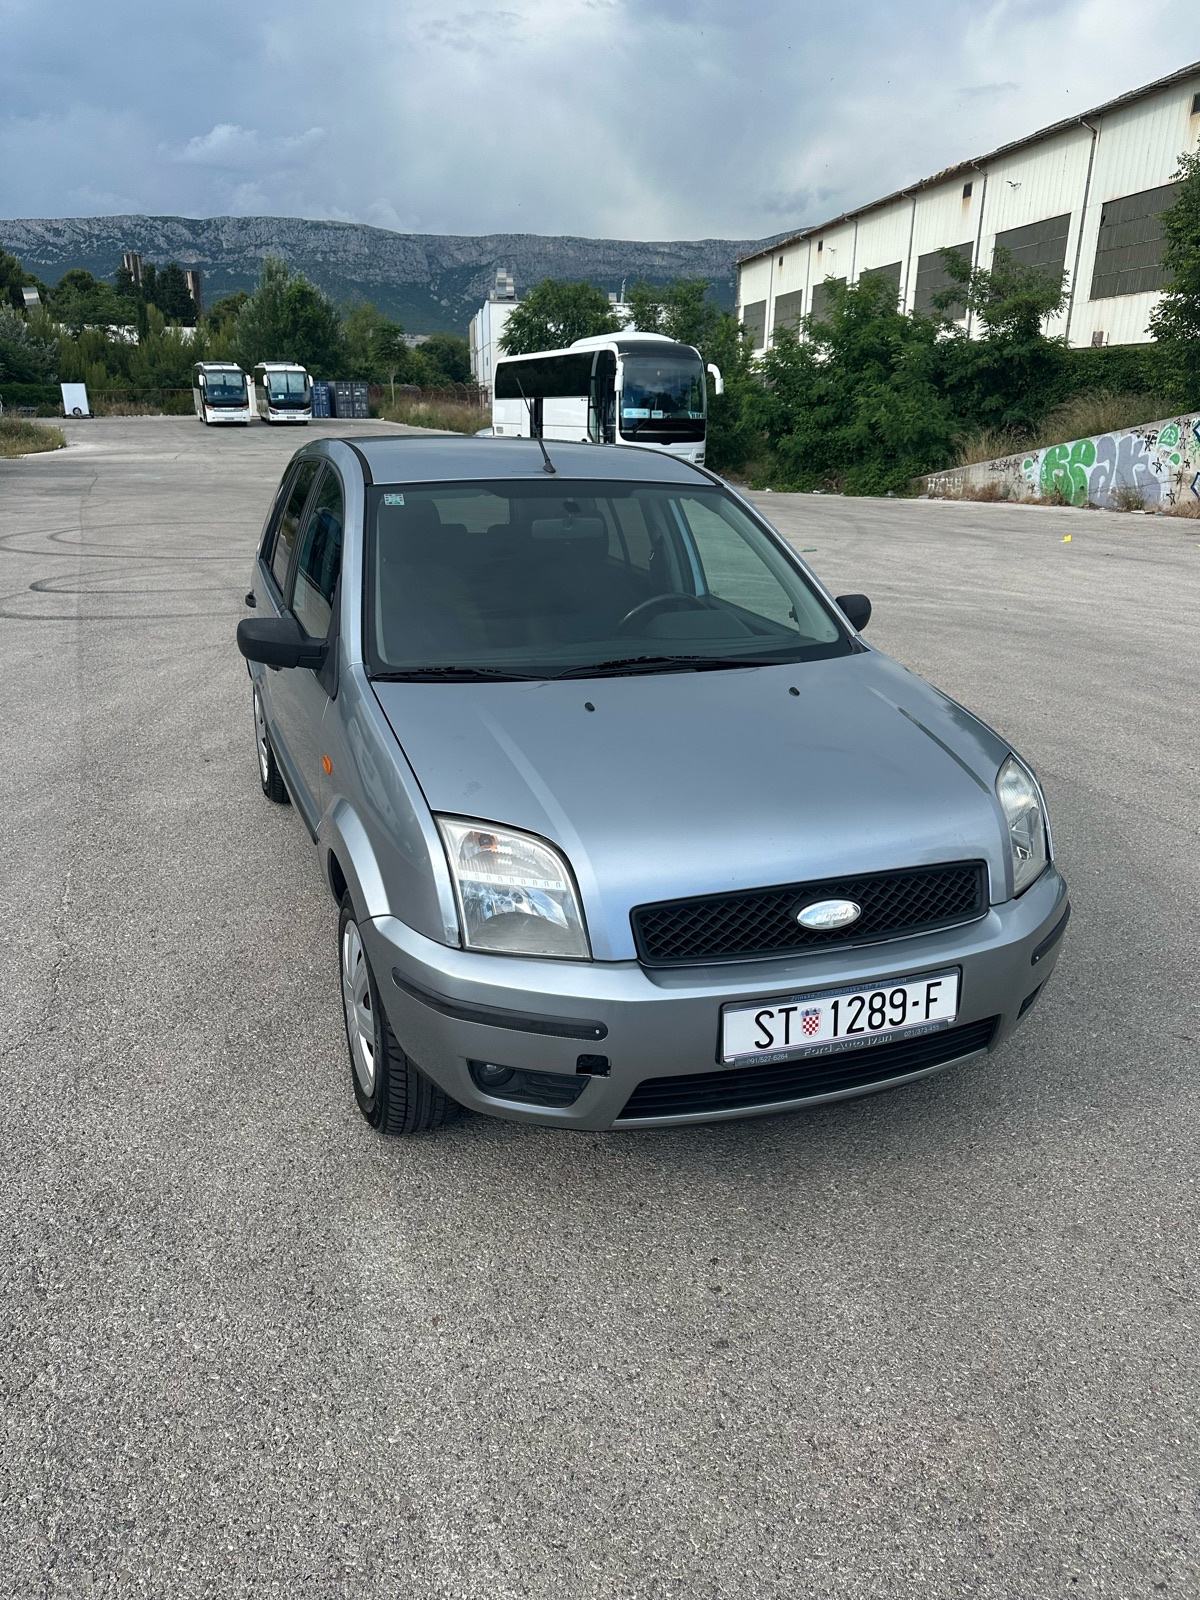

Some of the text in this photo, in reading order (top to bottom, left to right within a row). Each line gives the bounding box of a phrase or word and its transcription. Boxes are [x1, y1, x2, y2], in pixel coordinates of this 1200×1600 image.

[754, 981, 942, 1050] ST 1289-F
[804, 1033, 893, 1057] Ford Auto Ivan
